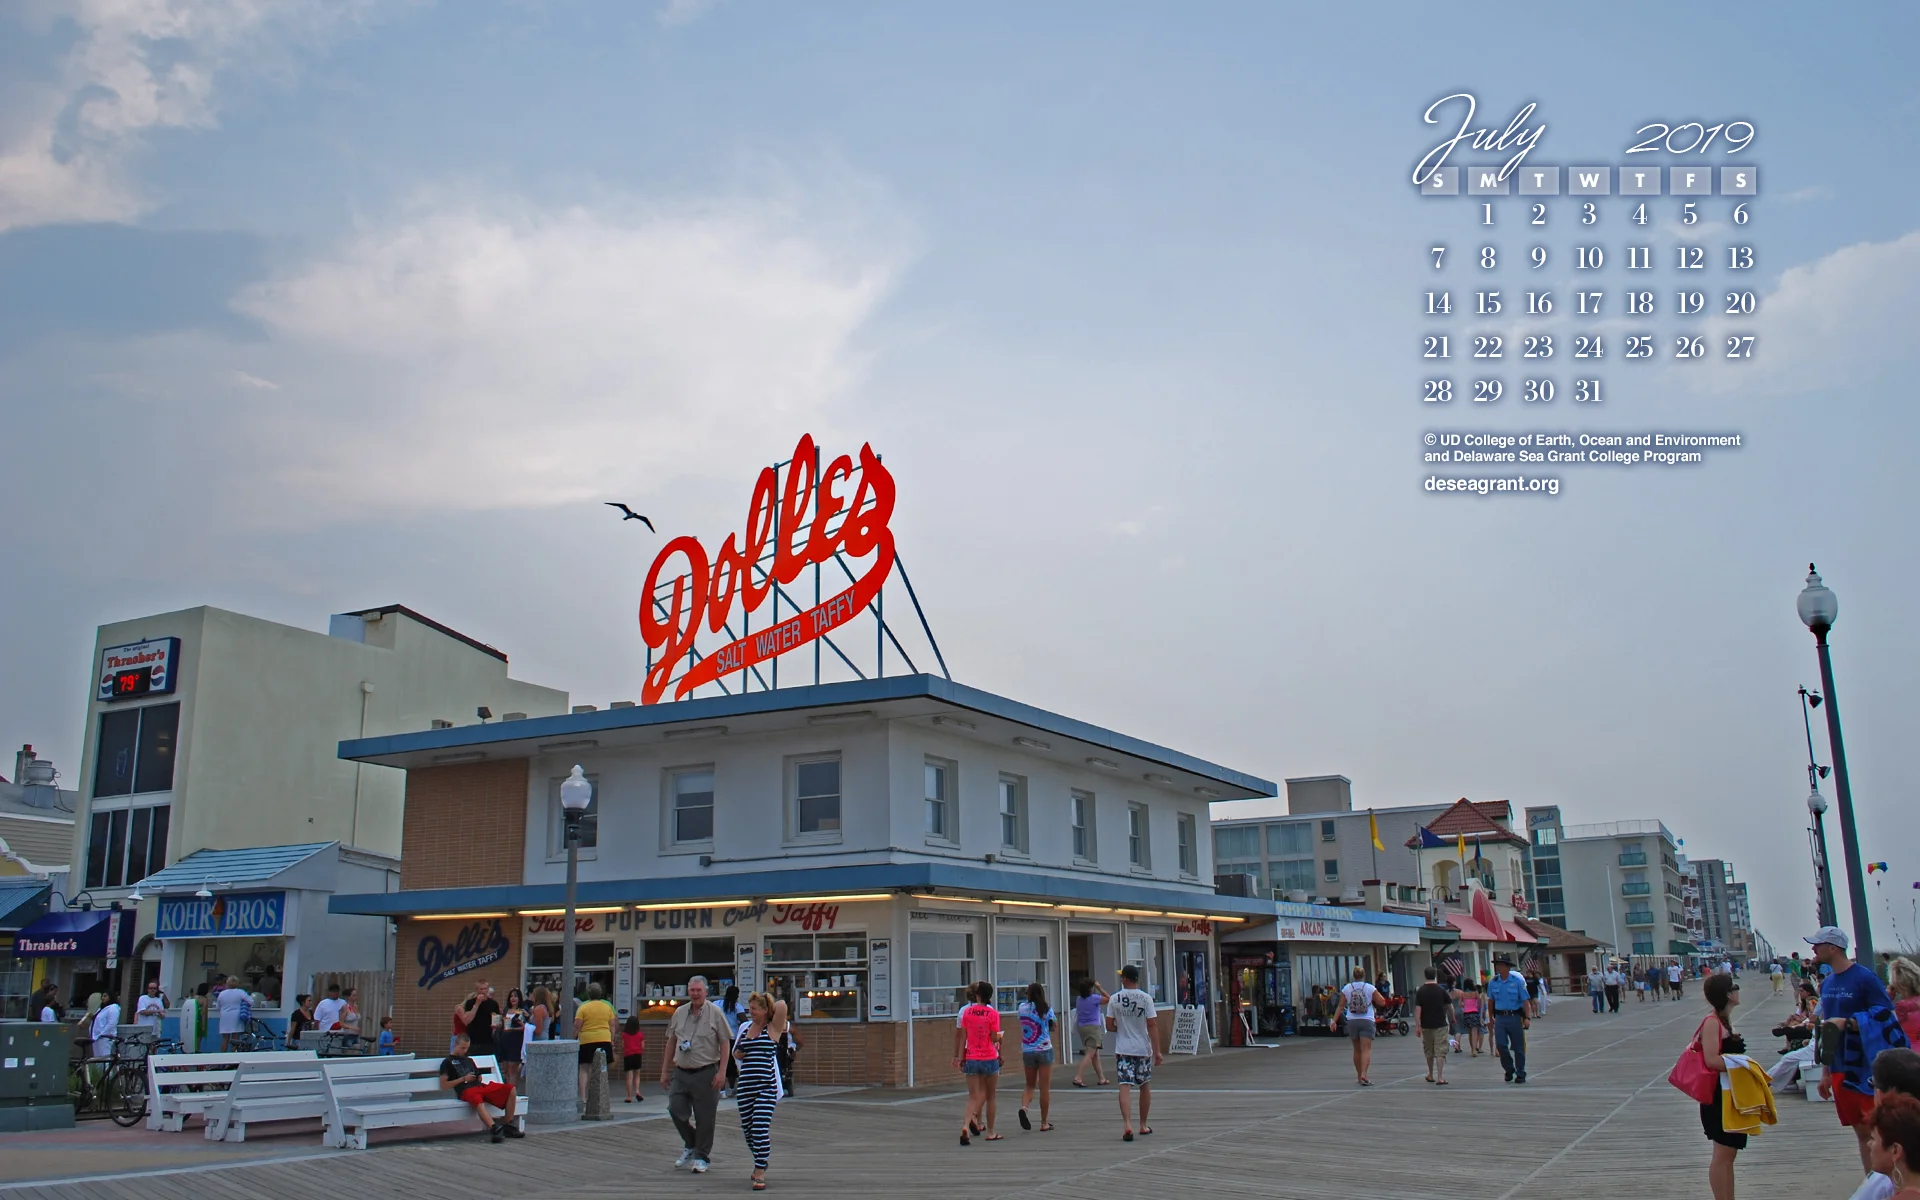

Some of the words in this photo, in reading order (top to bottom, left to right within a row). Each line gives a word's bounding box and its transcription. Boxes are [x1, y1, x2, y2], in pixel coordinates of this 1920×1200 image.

[716, 642, 747, 674] SALT
[756, 619, 801, 658] WATER
[810, 590, 857, 634] TAFFY
[107, 648, 165, 669] Thrasher's
[160, 901, 212, 931] KOHR
[772, 902, 840, 931] Taffy
[1192, 918, 1212, 936] Taffy
[1300, 921, 1325, 936] ARCADE
[19, 938, 77, 951] Thrasher's
[443, 968, 456, 978] SALT
[457, 960, 477, 972] WATER
[478, 951, 498, 965] TAFFY
